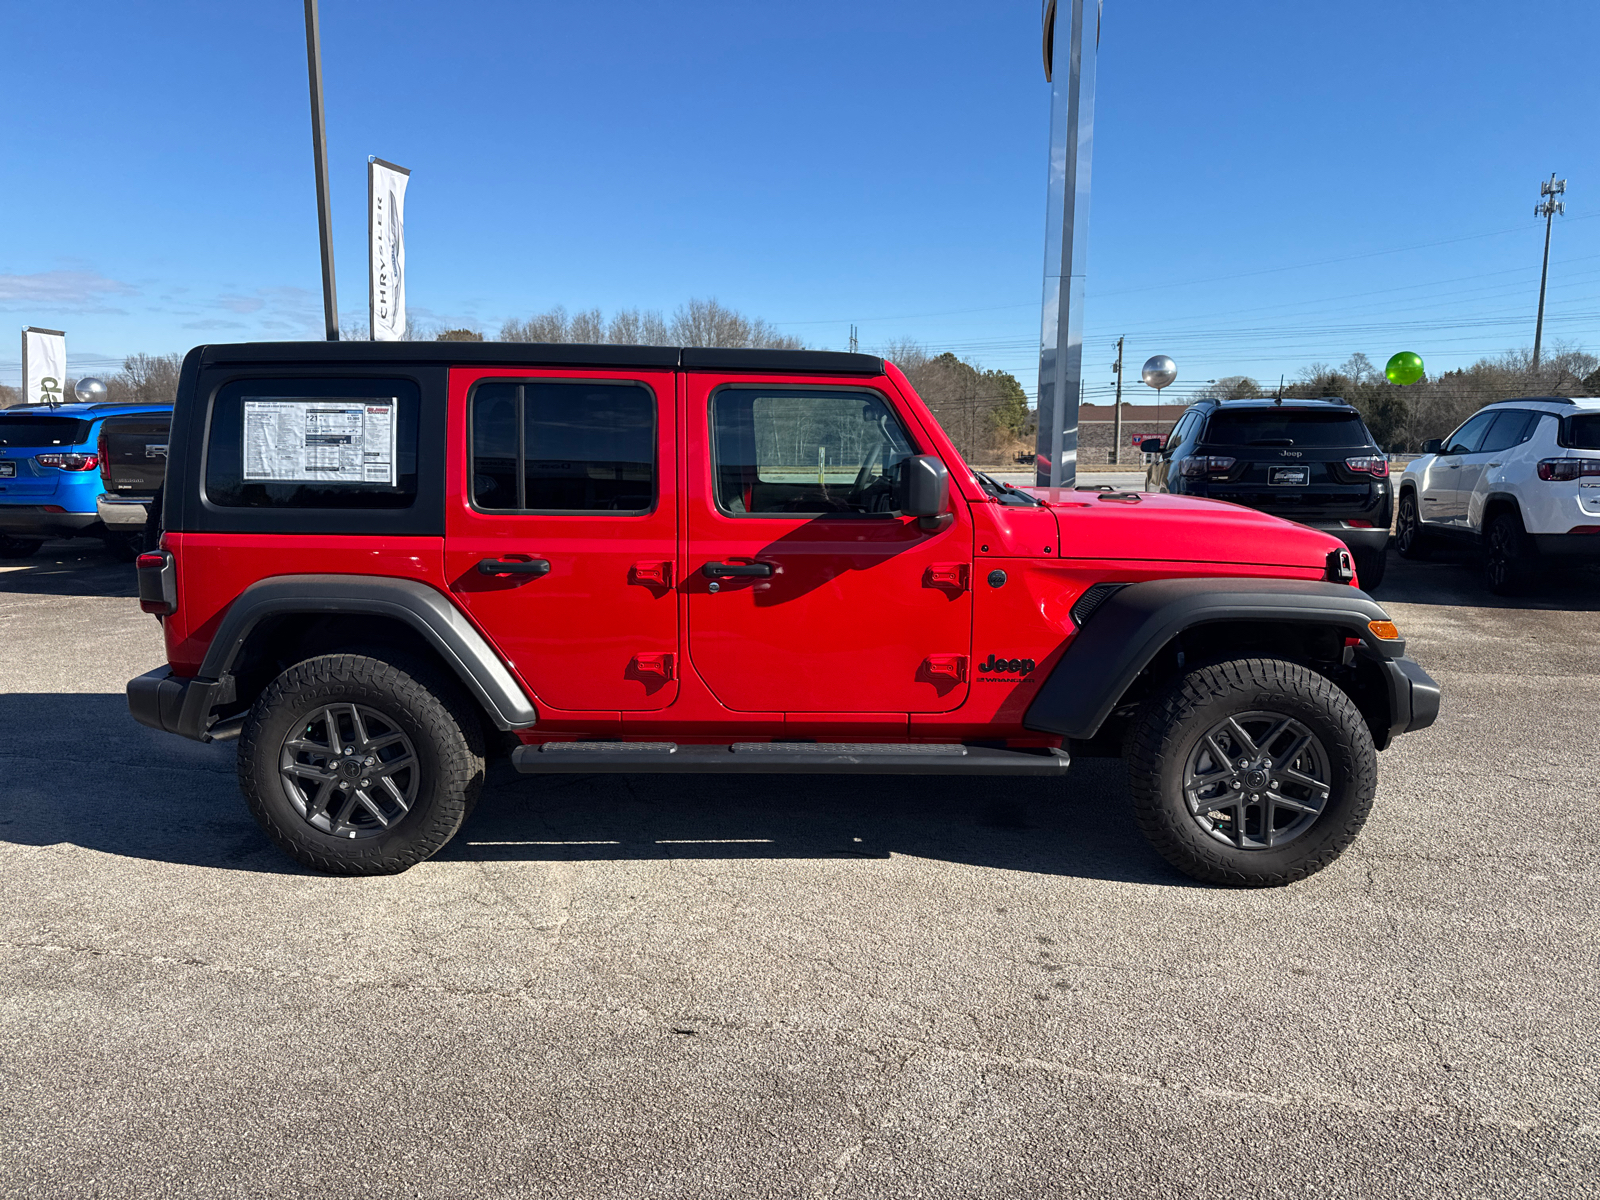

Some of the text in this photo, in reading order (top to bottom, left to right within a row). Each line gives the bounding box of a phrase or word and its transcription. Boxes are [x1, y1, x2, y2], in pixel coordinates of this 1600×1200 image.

[375, 197, 387, 320] CHRYSLER
[1280, 450, 1303, 459] Jeep
[980, 653, 1036, 677] Jeep
